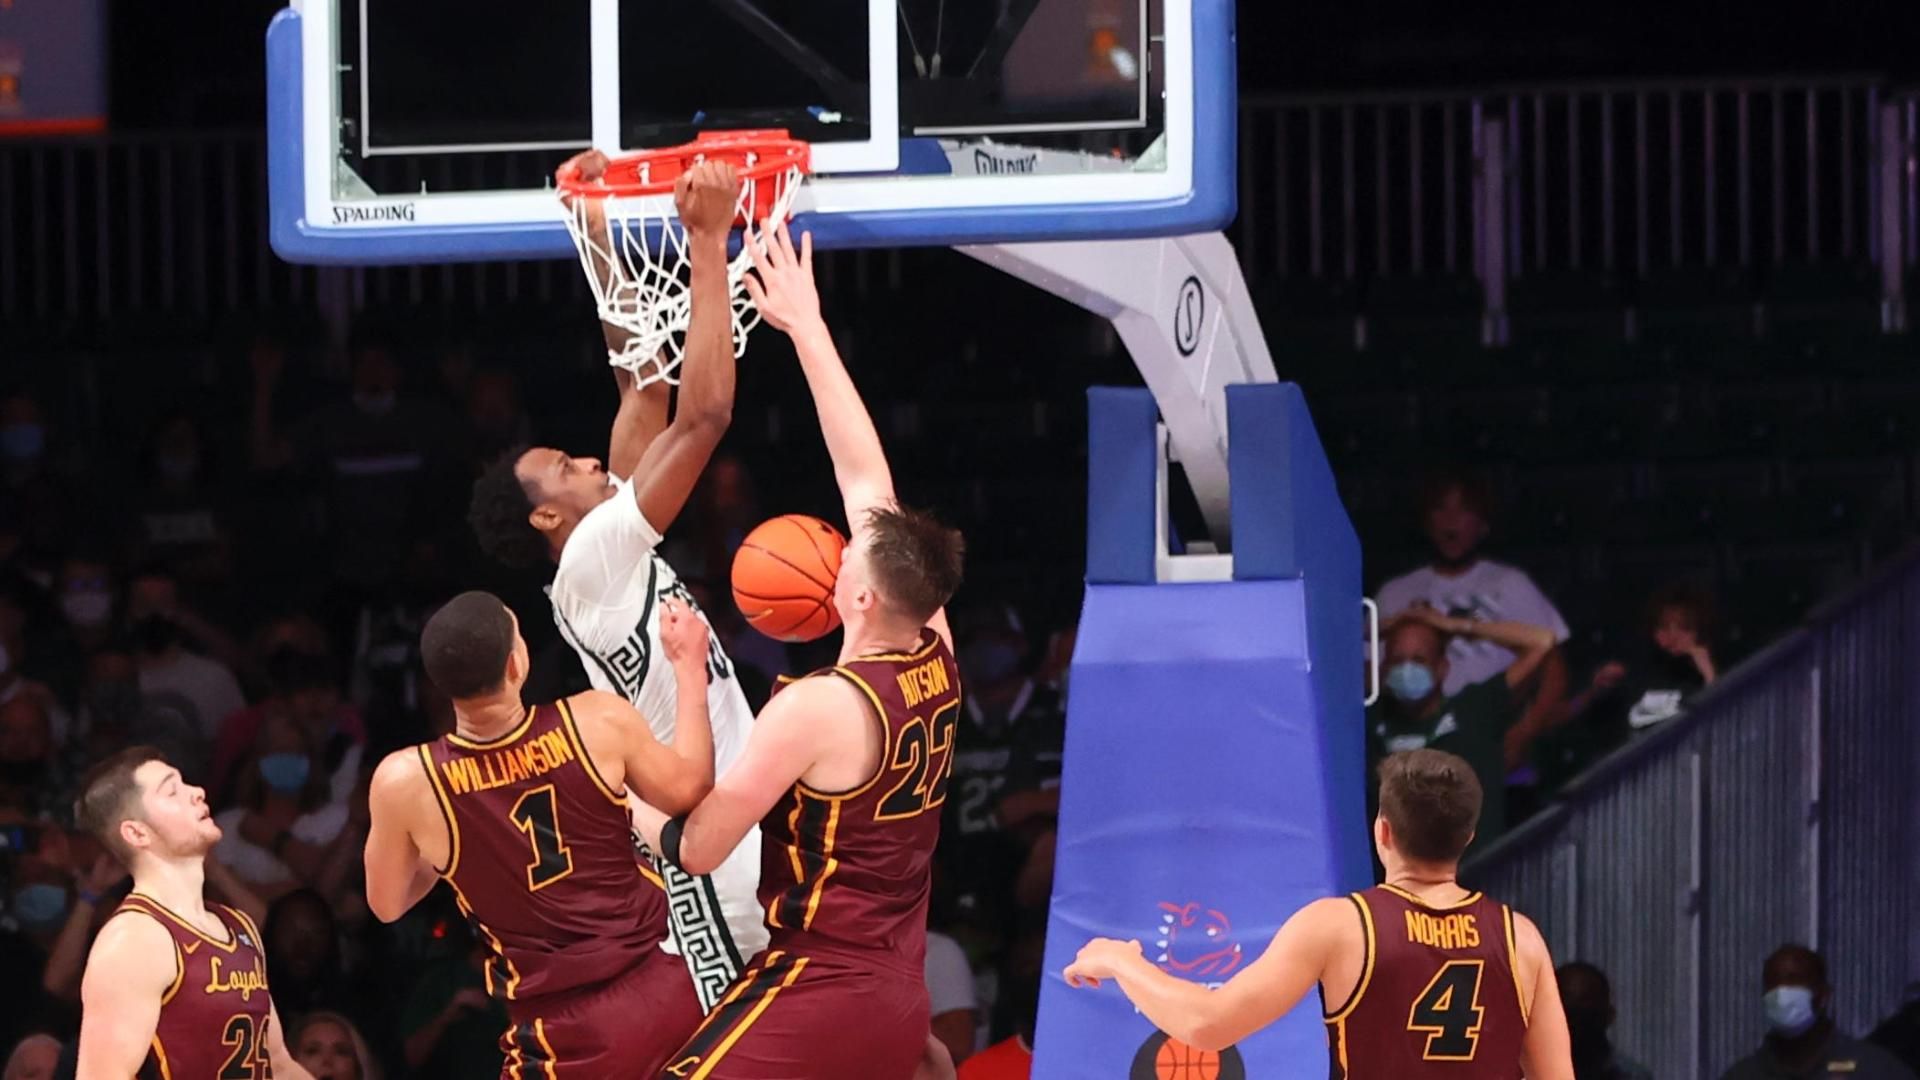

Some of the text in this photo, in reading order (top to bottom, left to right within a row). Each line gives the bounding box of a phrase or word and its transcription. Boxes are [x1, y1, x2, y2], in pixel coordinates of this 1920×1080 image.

[332, 203, 415, 224] SPALDING
[896, 655, 950, 709] HUTSON
[441, 727, 574, 795] WILLIAMSON
[873, 698, 959, 821] 22
[509, 783, 573, 892] 1
[1405, 910, 1480, 948] NORRIS
[206, 956, 268, 1001] Loyol
[1407, 959, 1484, 1060] 4
